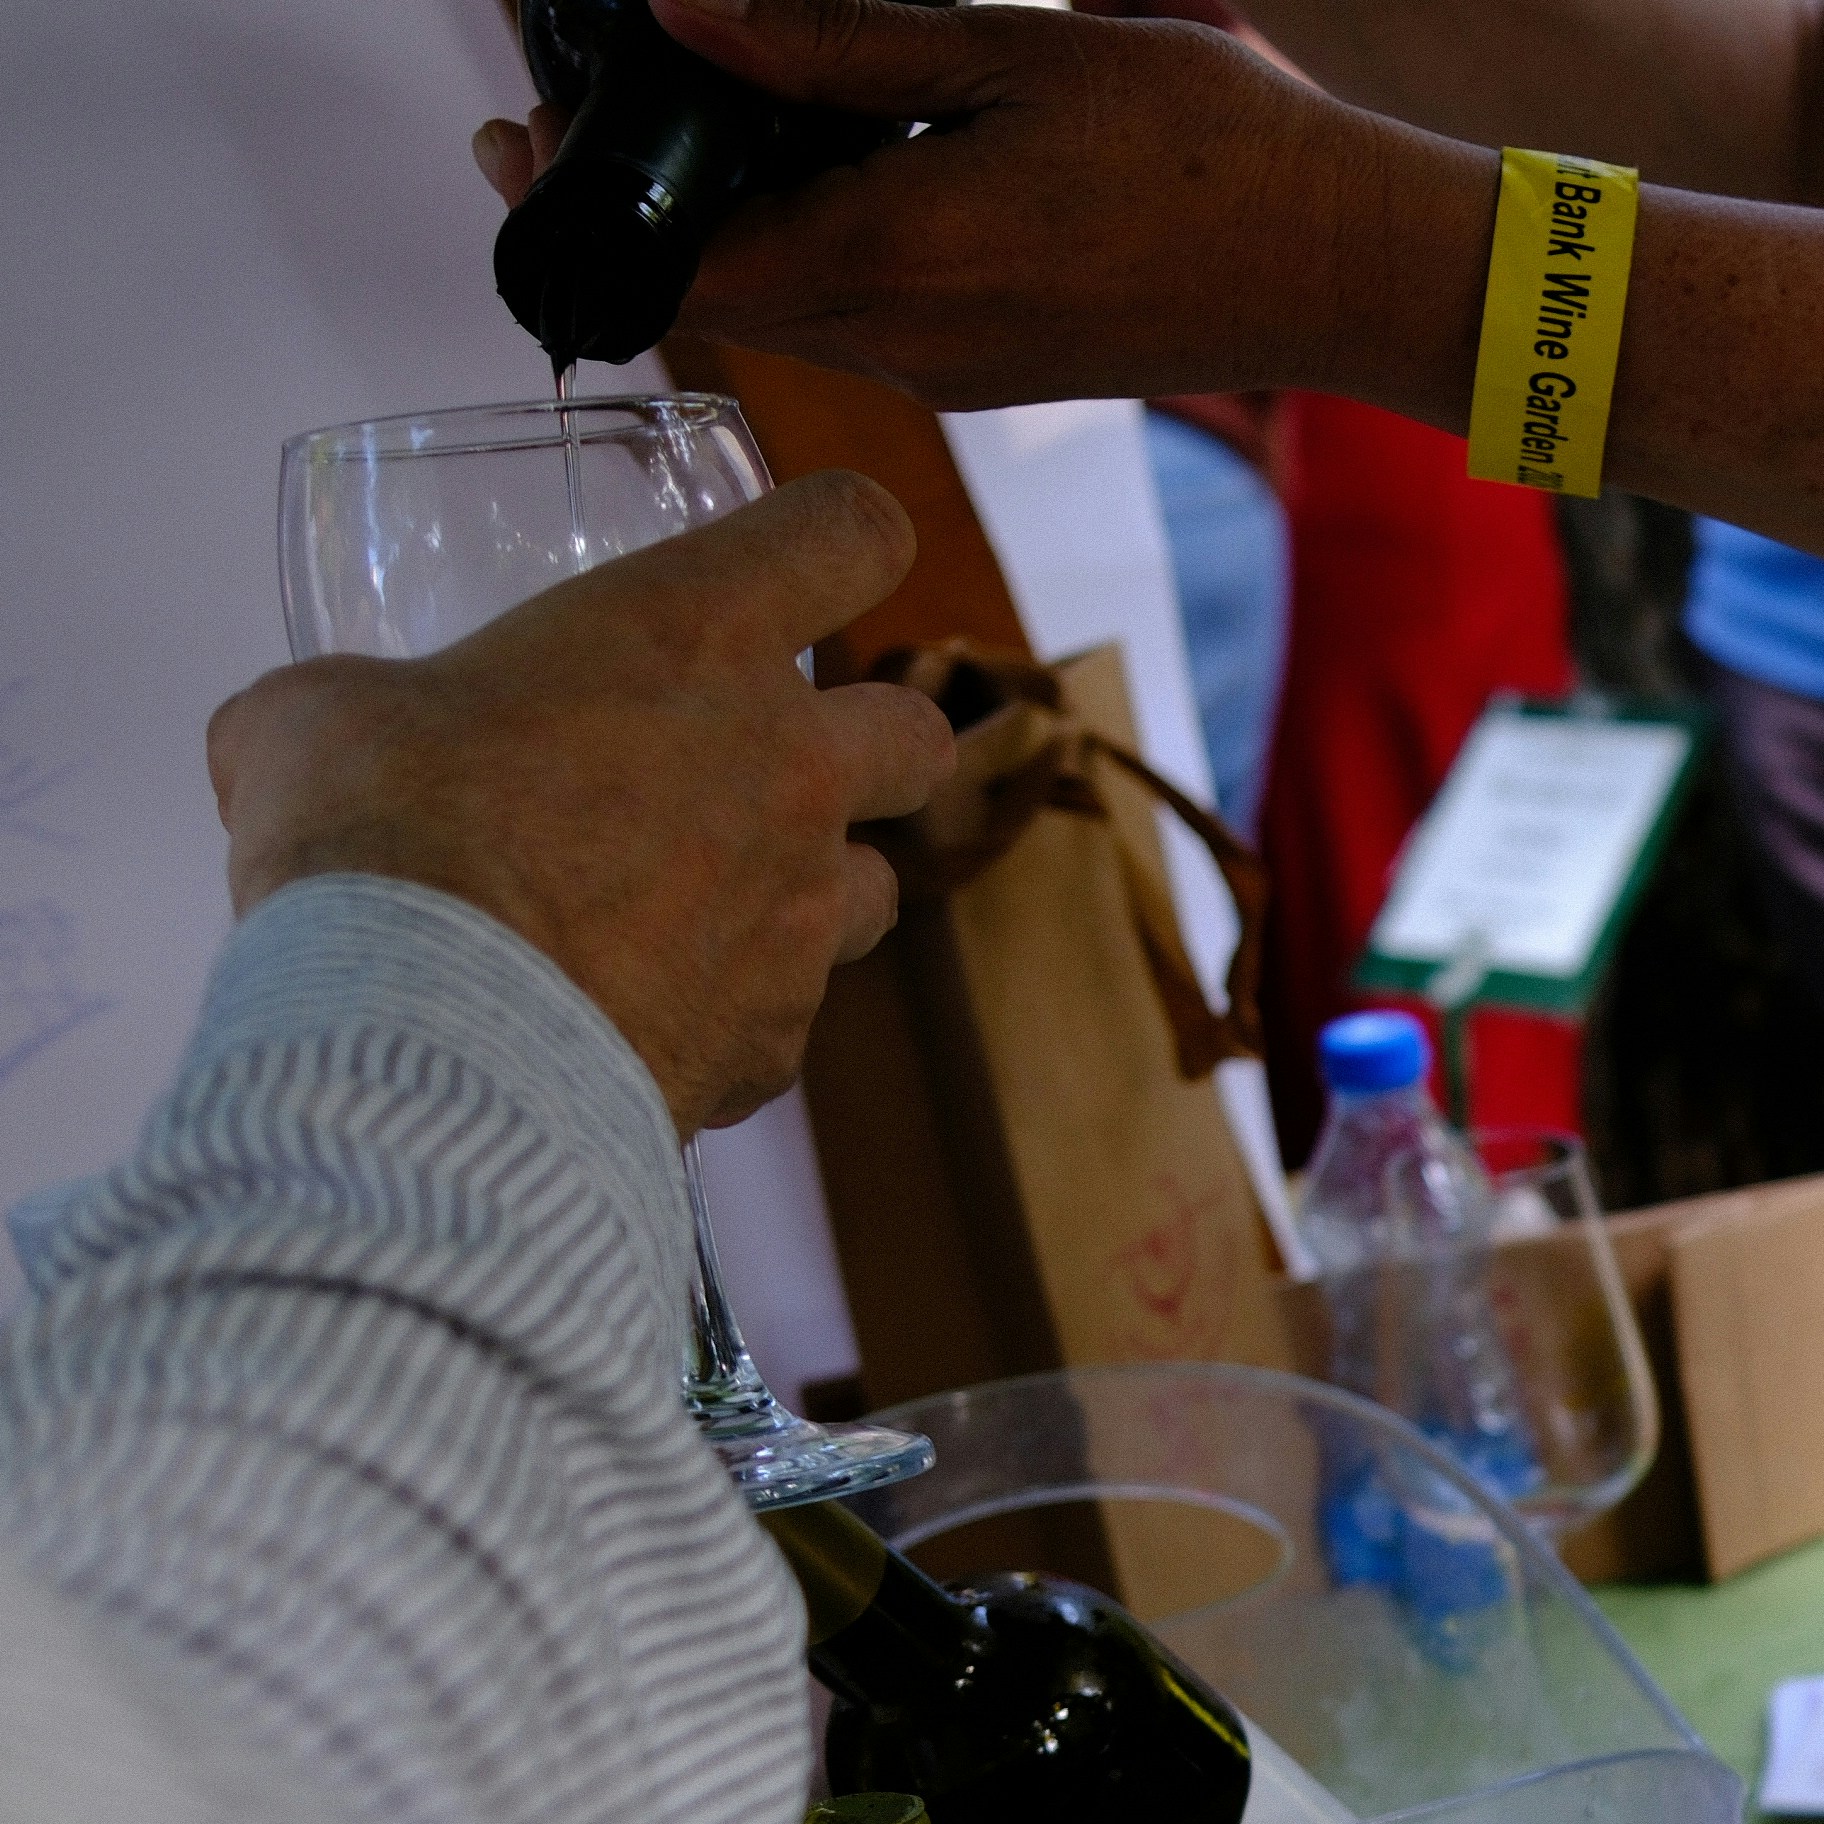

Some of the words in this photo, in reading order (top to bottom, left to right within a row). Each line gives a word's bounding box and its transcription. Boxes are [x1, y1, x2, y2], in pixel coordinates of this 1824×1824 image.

[1547, 181, 1602, 260] Bank
[1533, 273, 1591, 360] Wine
[1520, 371, 1576, 464] Garden
